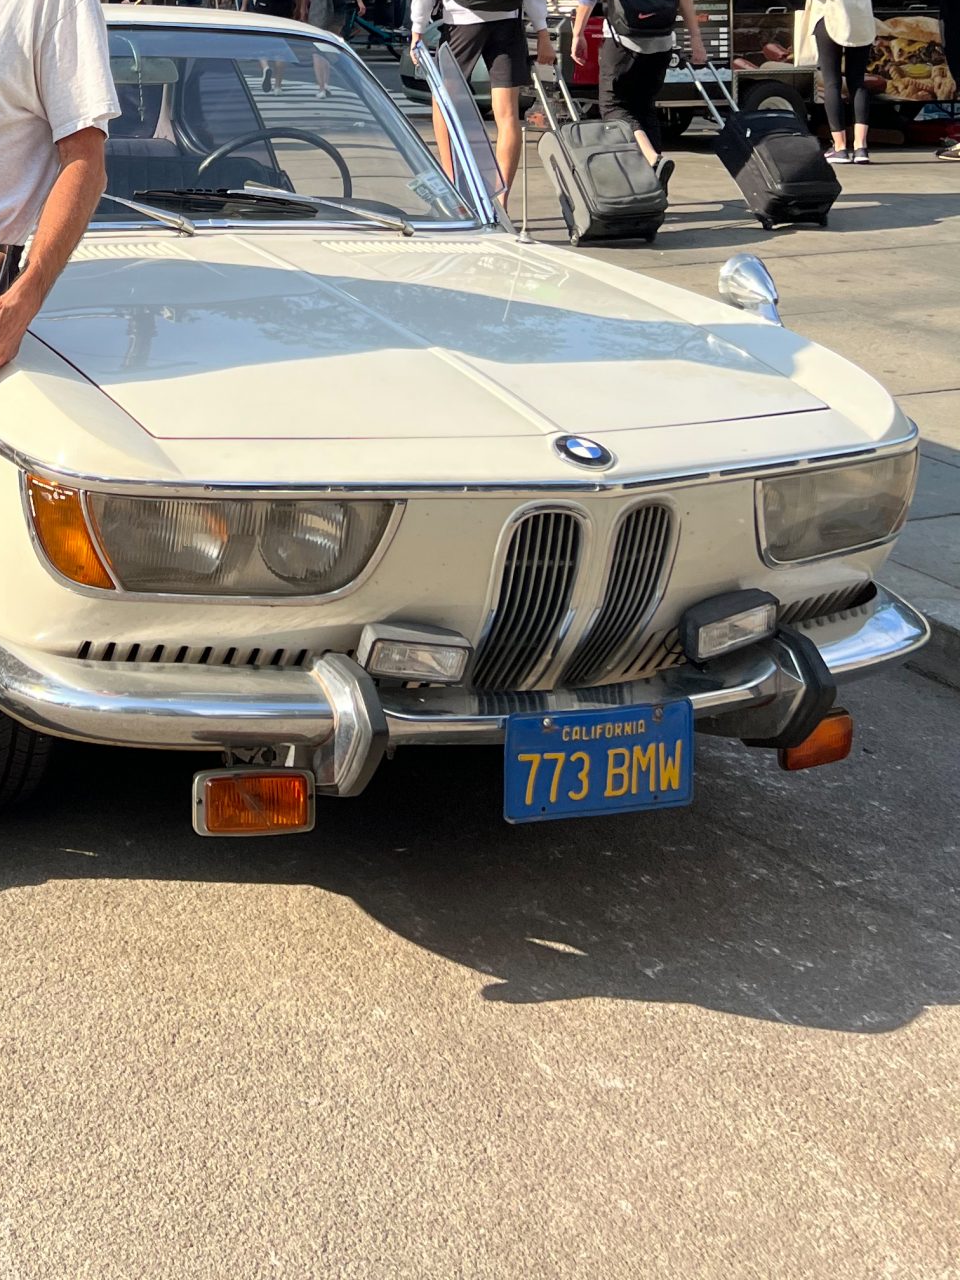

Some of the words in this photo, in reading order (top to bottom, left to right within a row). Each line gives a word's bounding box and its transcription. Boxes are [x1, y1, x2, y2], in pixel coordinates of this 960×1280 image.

[562, 719, 646, 742] CALIFORNIA
[518, 752, 590, 805] 773
[603, 739, 683, 798] BMW
